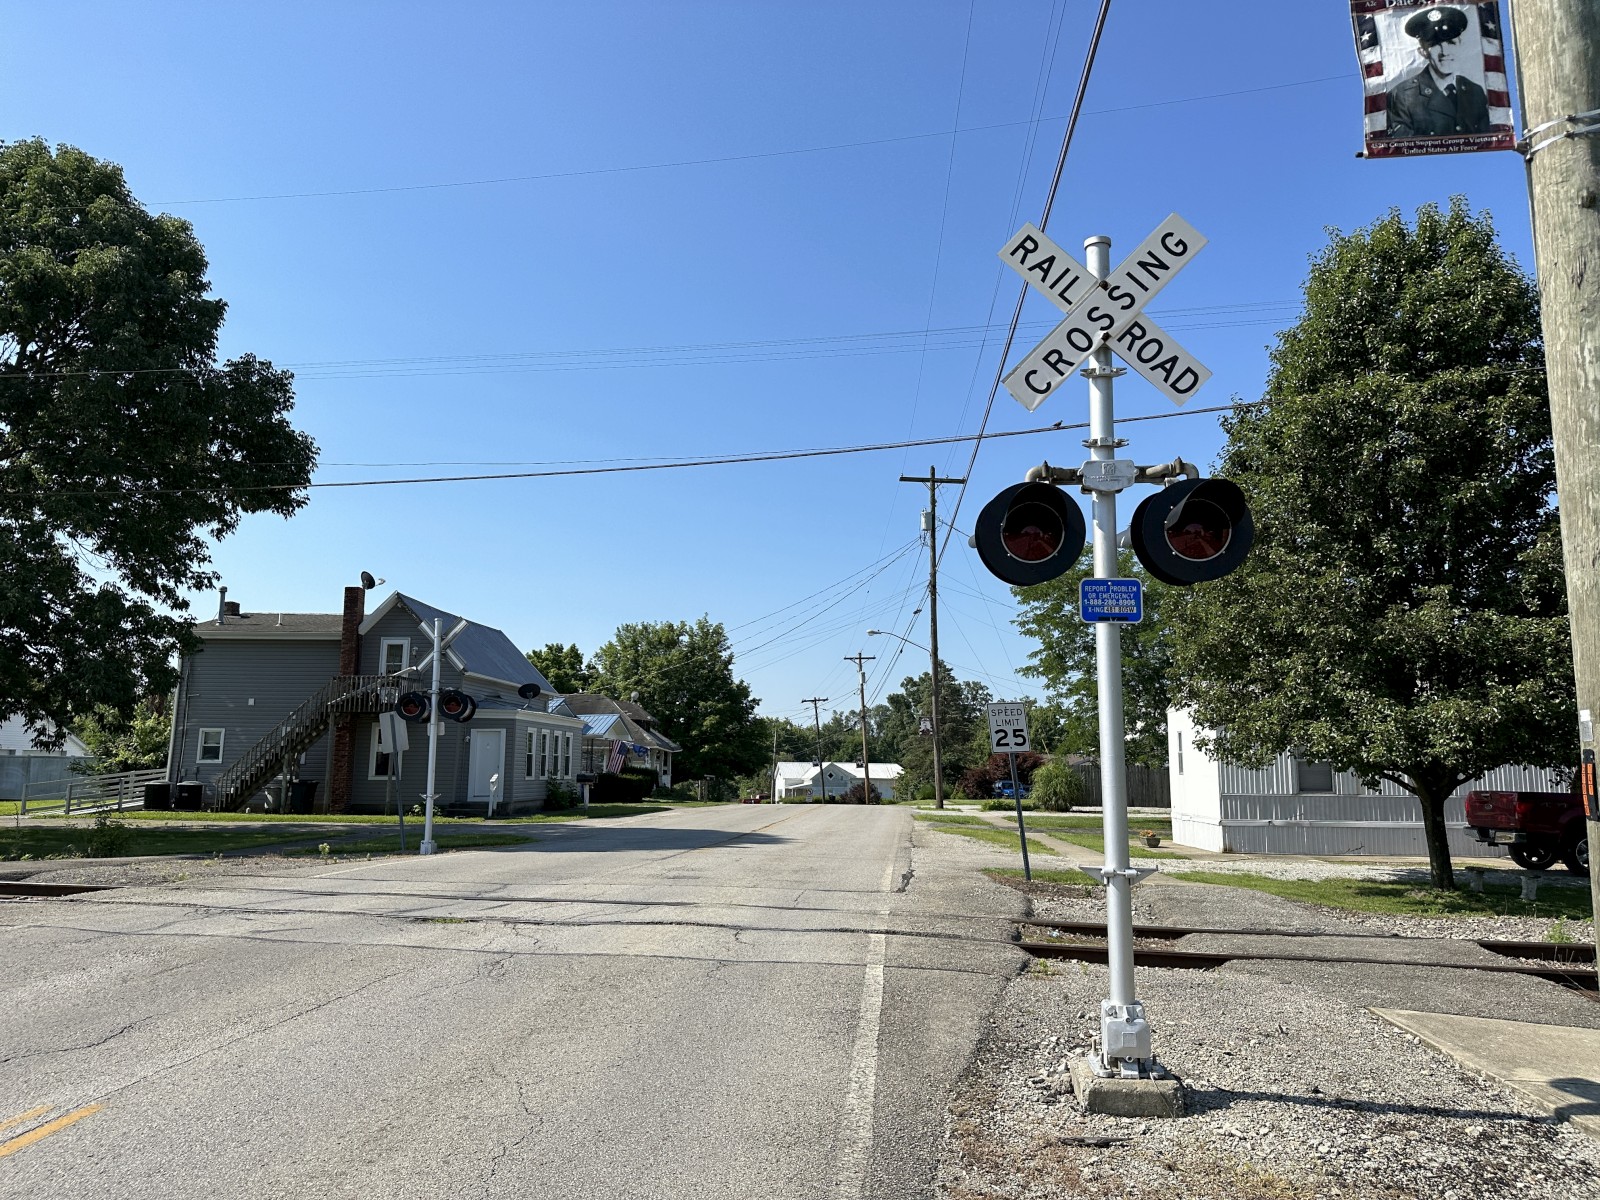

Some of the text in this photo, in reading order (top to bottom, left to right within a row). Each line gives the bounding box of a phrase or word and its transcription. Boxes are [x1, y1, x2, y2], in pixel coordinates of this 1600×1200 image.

[1009, 234, 1200, 395] RAIL ROAD
[1024, 231, 1188, 395] CROSSING
[991, 708, 1022, 716] SPEED
[994, 729, 1026, 747] 25
